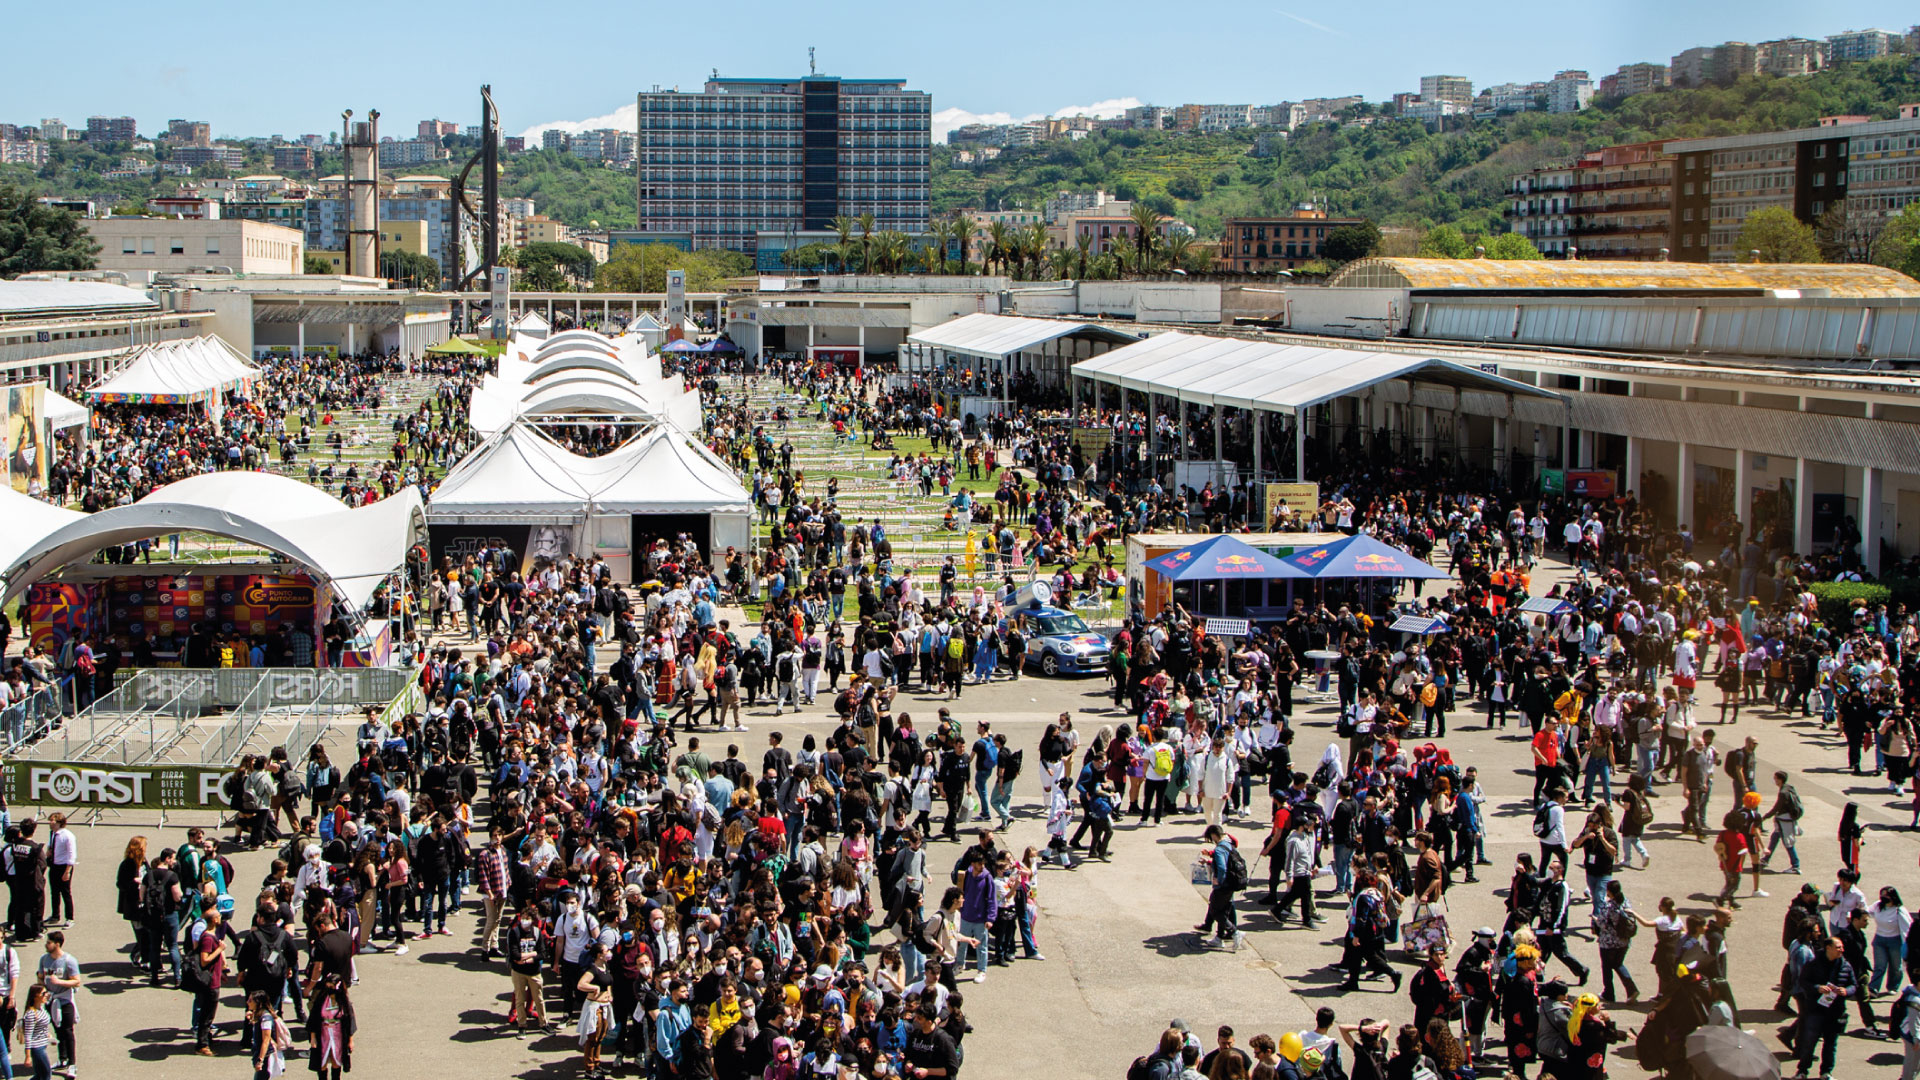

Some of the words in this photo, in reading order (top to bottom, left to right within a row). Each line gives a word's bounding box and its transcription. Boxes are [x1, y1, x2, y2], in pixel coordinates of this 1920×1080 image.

[39, 333, 48, 341] 10
[1215, 564, 1240, 573] Red
[1241, 564, 1265, 573] Bull
[1354, 563, 1379, 572] Red
[1380, 564, 1405, 572] Bull
[161, 770, 184, 779] BIRRA
[31, 767, 152, 804] FORST
[161, 789, 184, 798] BEER
[161, 798, 185, 806] BIER
[12, 843, 32, 855] VANS
